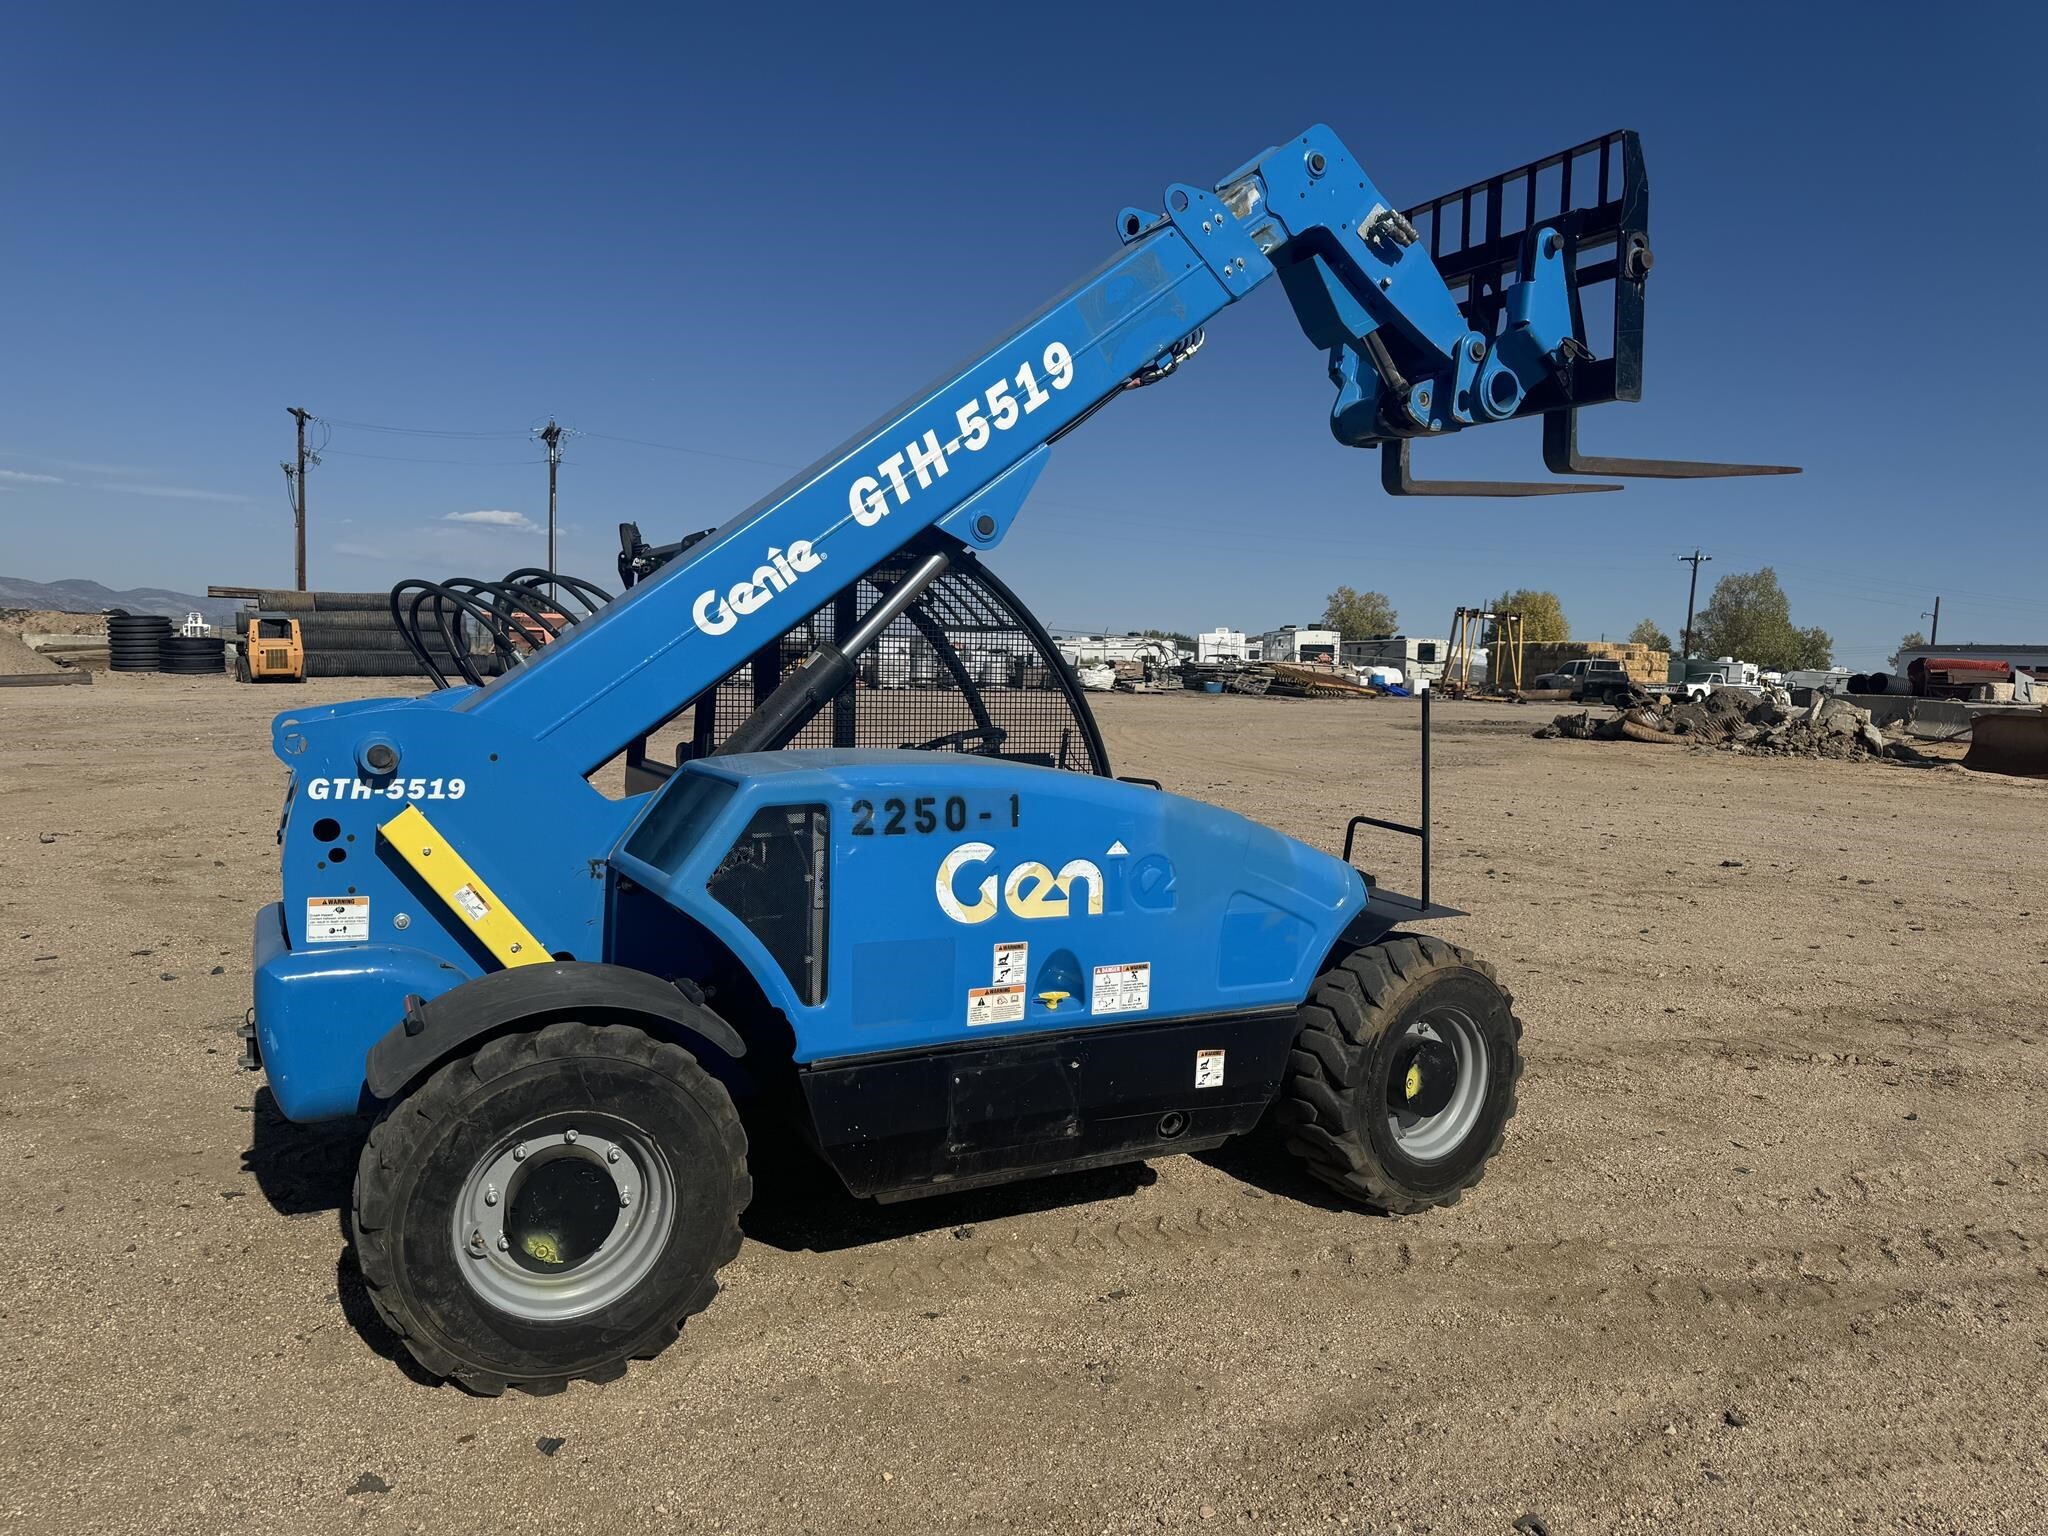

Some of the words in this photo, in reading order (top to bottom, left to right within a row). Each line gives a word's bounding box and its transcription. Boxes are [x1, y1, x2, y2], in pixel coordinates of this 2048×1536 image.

[848, 340, 1075, 528] GTH-5519
[692, 538, 826, 637] Genie
[307, 777, 466, 800] GTH-5519
[328, 898, 355, 906] WARNING
